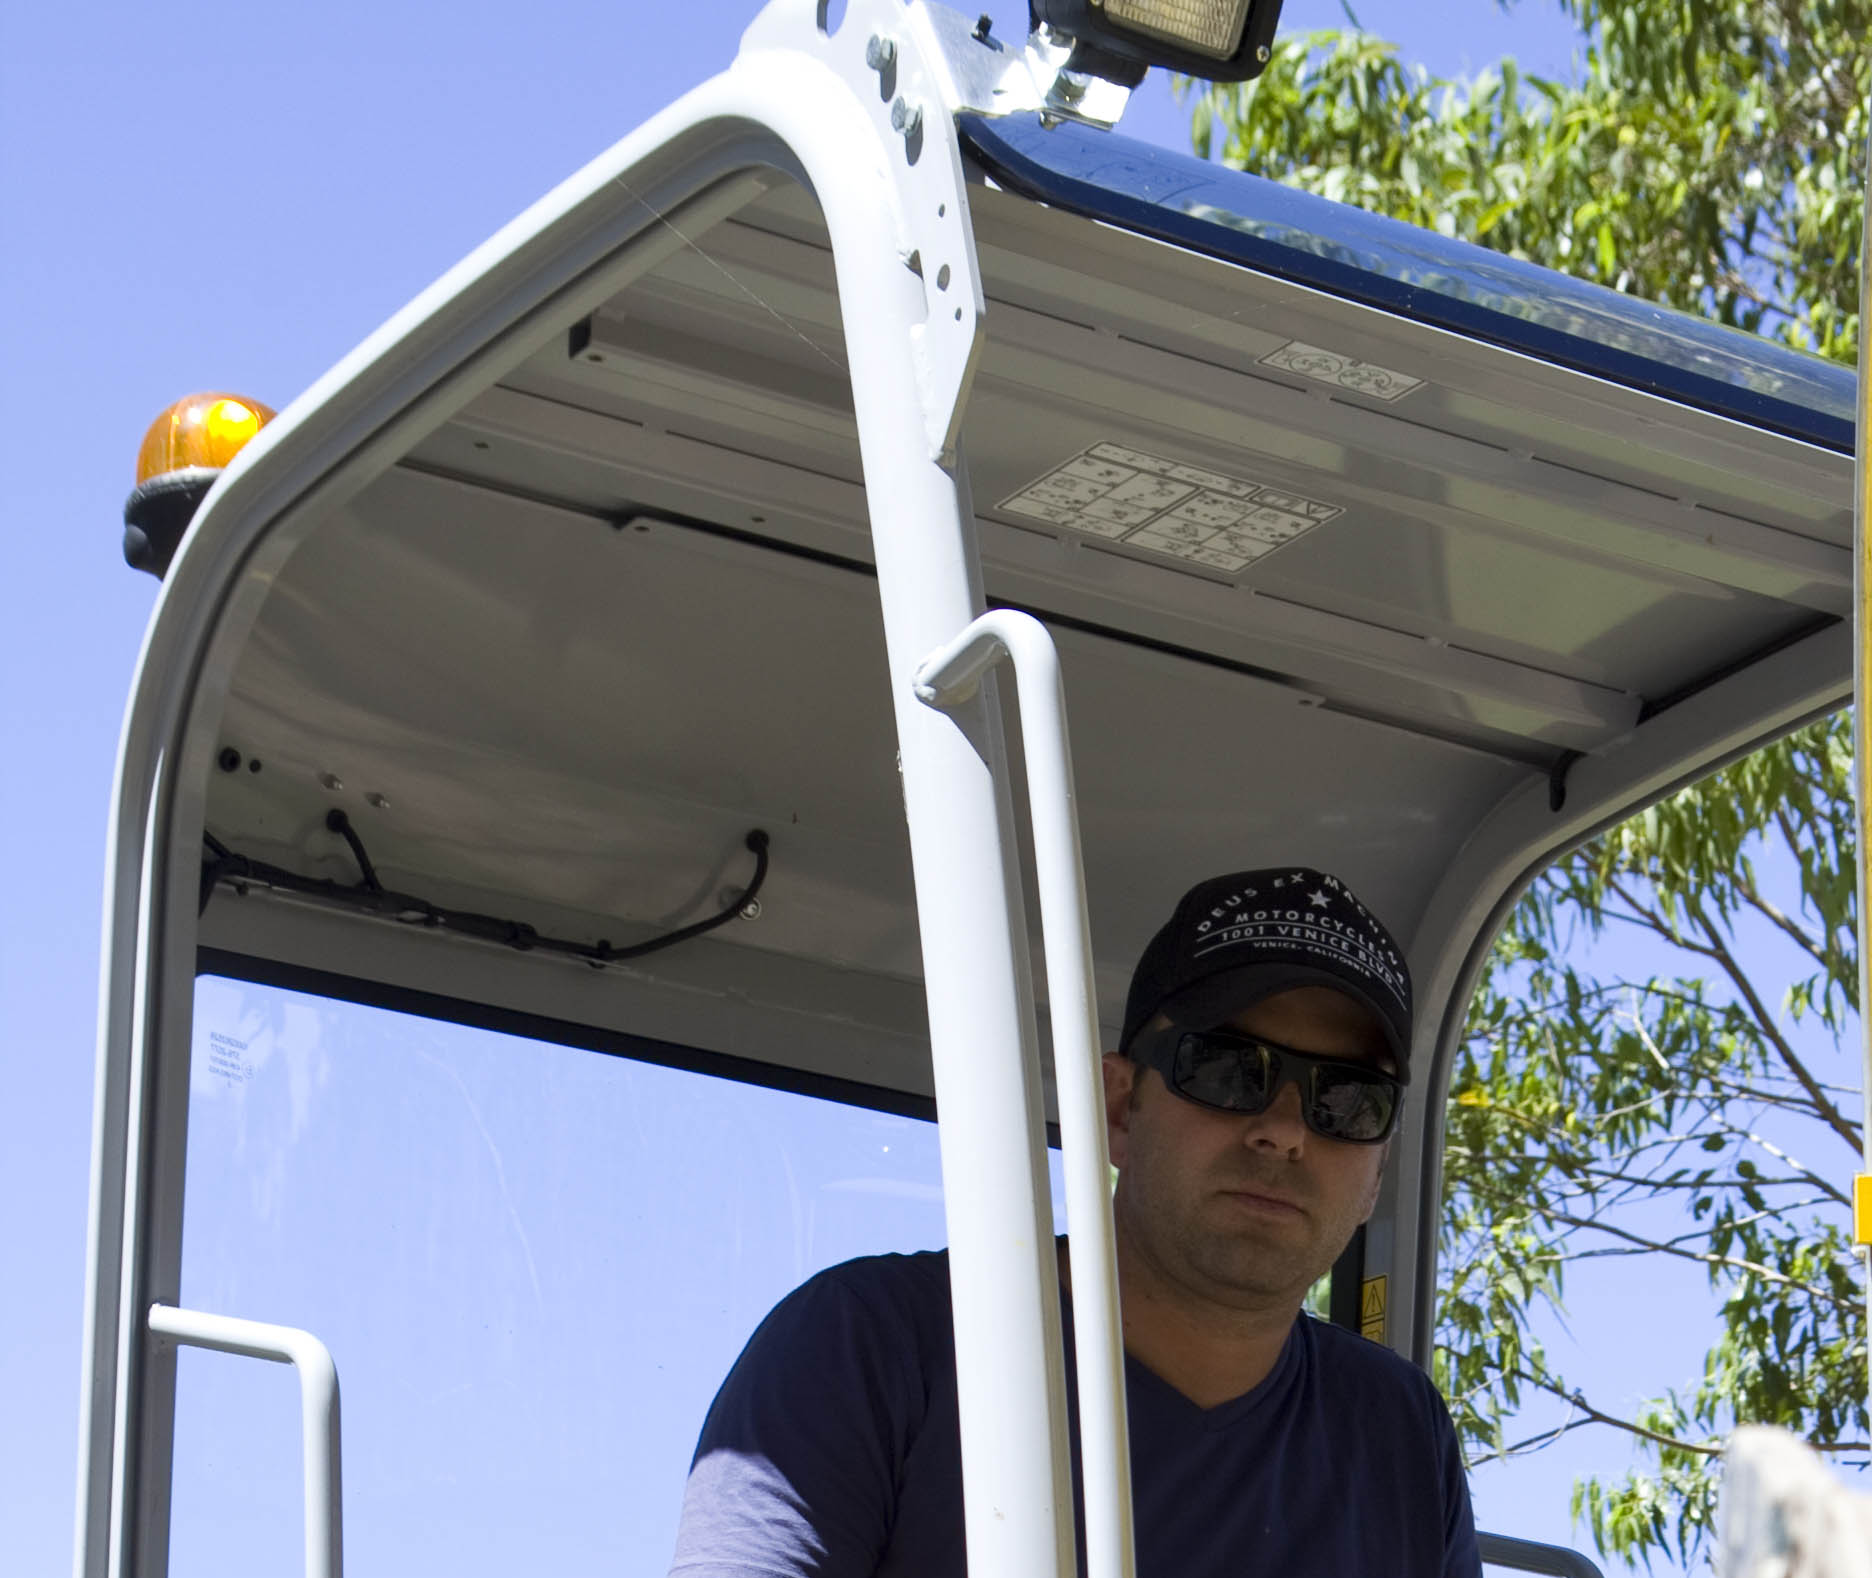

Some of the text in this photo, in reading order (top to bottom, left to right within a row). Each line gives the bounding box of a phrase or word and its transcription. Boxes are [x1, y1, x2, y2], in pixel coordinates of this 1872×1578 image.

[1197, 888, 1258, 932] DEUS
[1273, 872, 1304, 888] EX
[1222, 925, 1393, 984] 1001 VENICE BLVD
[1235, 910, 1385, 962] MOTORCYCLES
[1306, 945, 1371, 978] CALIFORNIA
